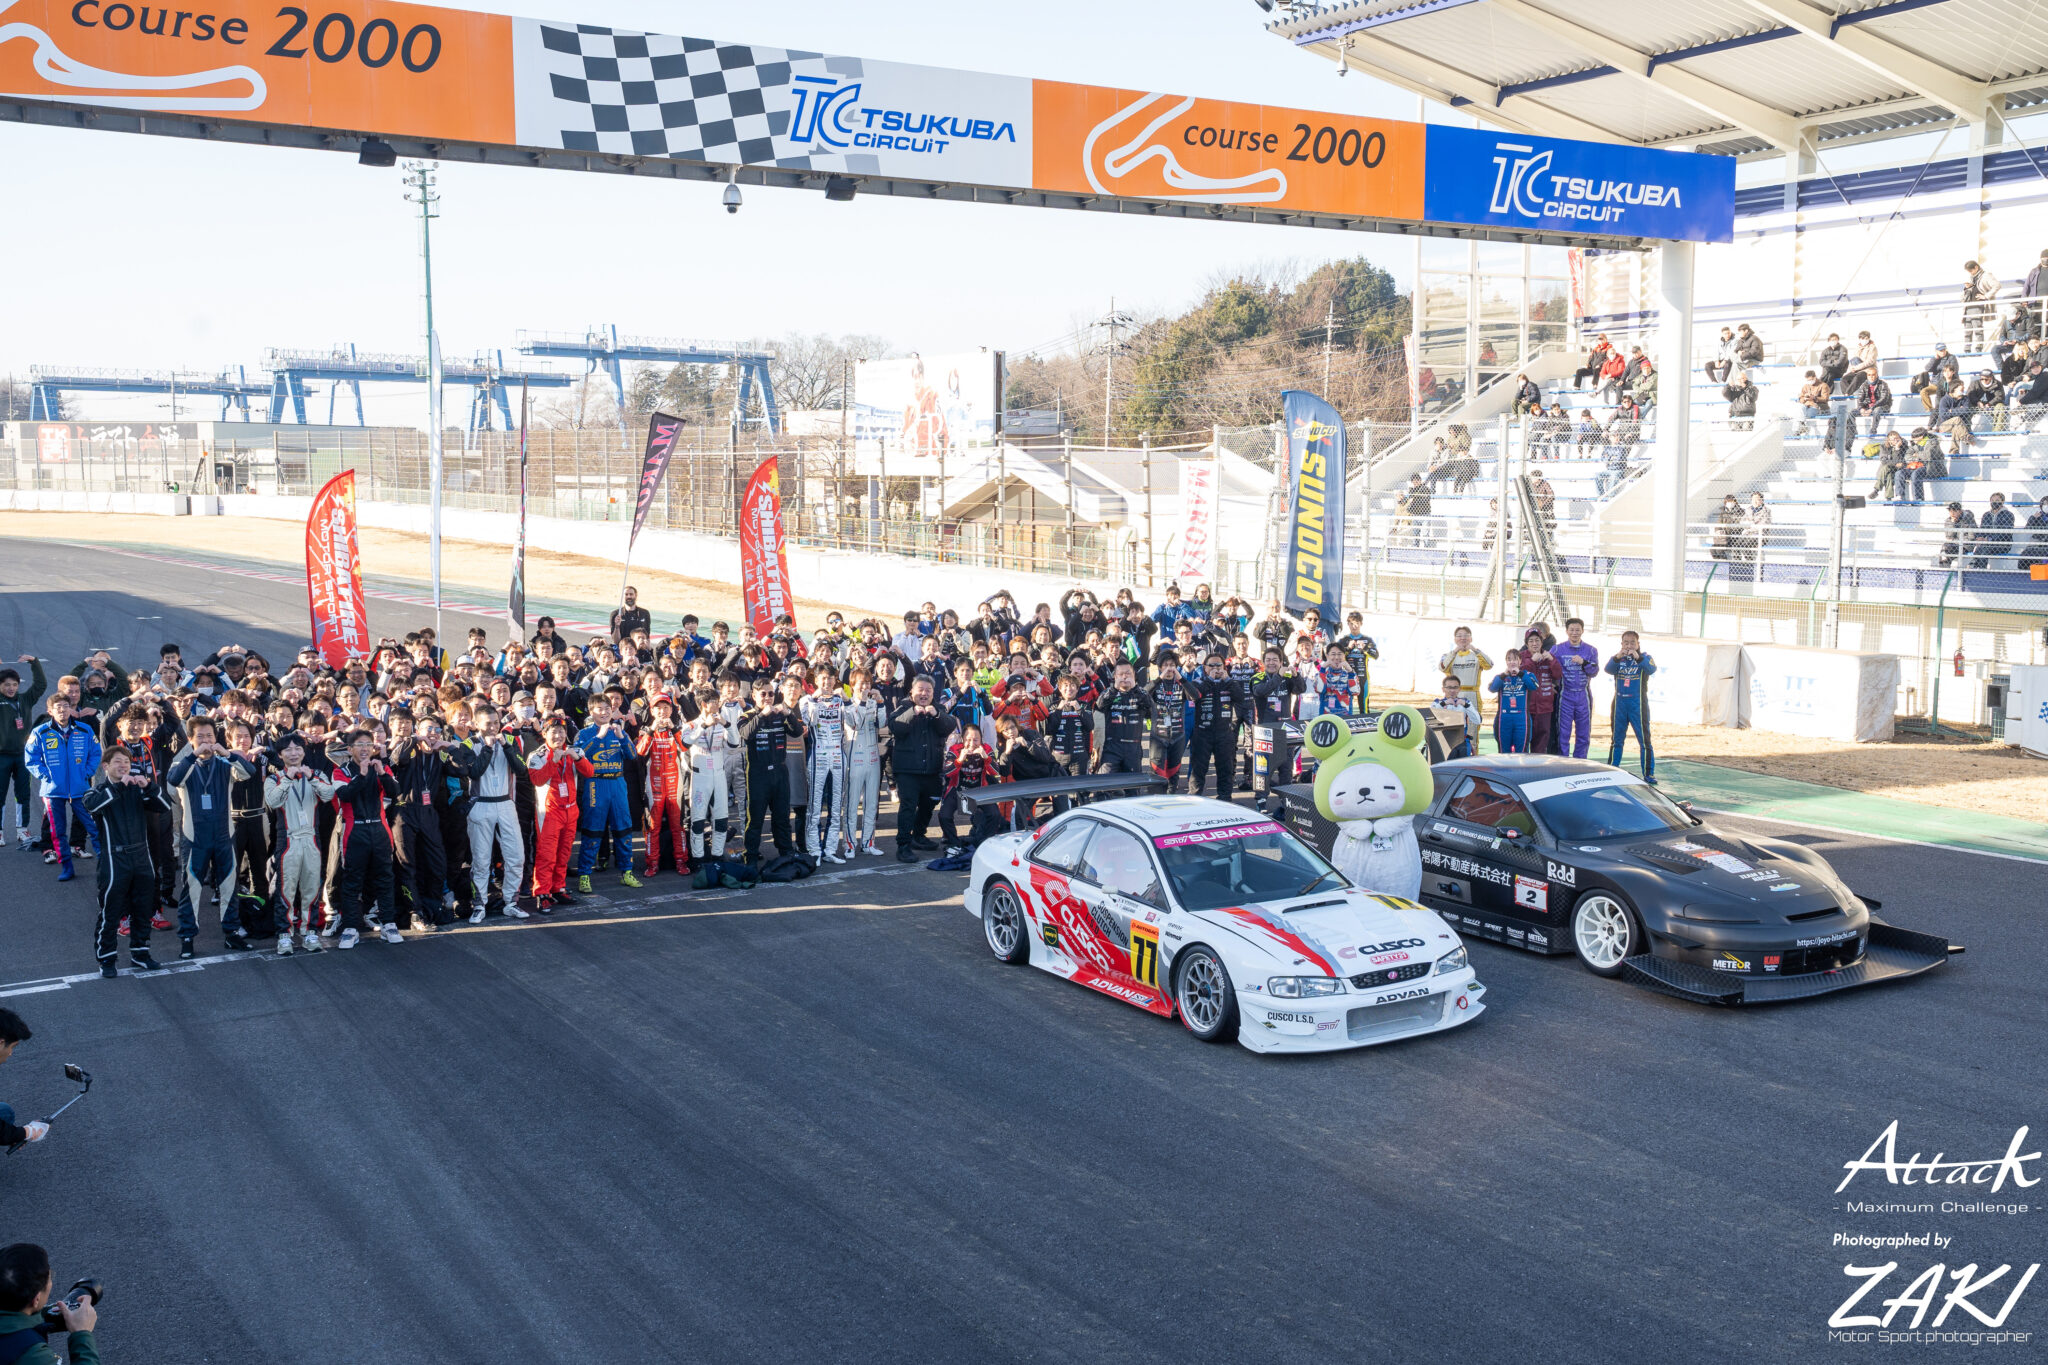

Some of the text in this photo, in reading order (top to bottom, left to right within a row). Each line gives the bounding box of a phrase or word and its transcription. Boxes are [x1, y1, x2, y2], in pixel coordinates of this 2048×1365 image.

[71, 0, 443, 74] course 2000
[860, 107, 1017, 143] TSUKUBA
[1183, 123, 1386, 168] course 2000
[1551, 175, 1682, 209] TSUKUBA
[1293, 425, 1338, 439] SUNOCO
[1296, 450, 1326, 605] SUNOCO
[1193, 816, 1249, 827] YOKOHAMA
[1188, 825, 1263, 843] SUBARU
[1526, 890, 1537, 904] 2
[1091, 906, 1112, 937] CLUTCH
[1097, 900, 1129, 947] SUSPENSION
[1358, 938, 1426, 955] CUSCO
[1712, 957, 1751, 969] METEOR
[1088, 978, 1135, 998] ADVAN
[1376, 988, 1430, 1004] ADVAN
[1267, 1011, 1316, 1025] CUSCO L.S.D.
